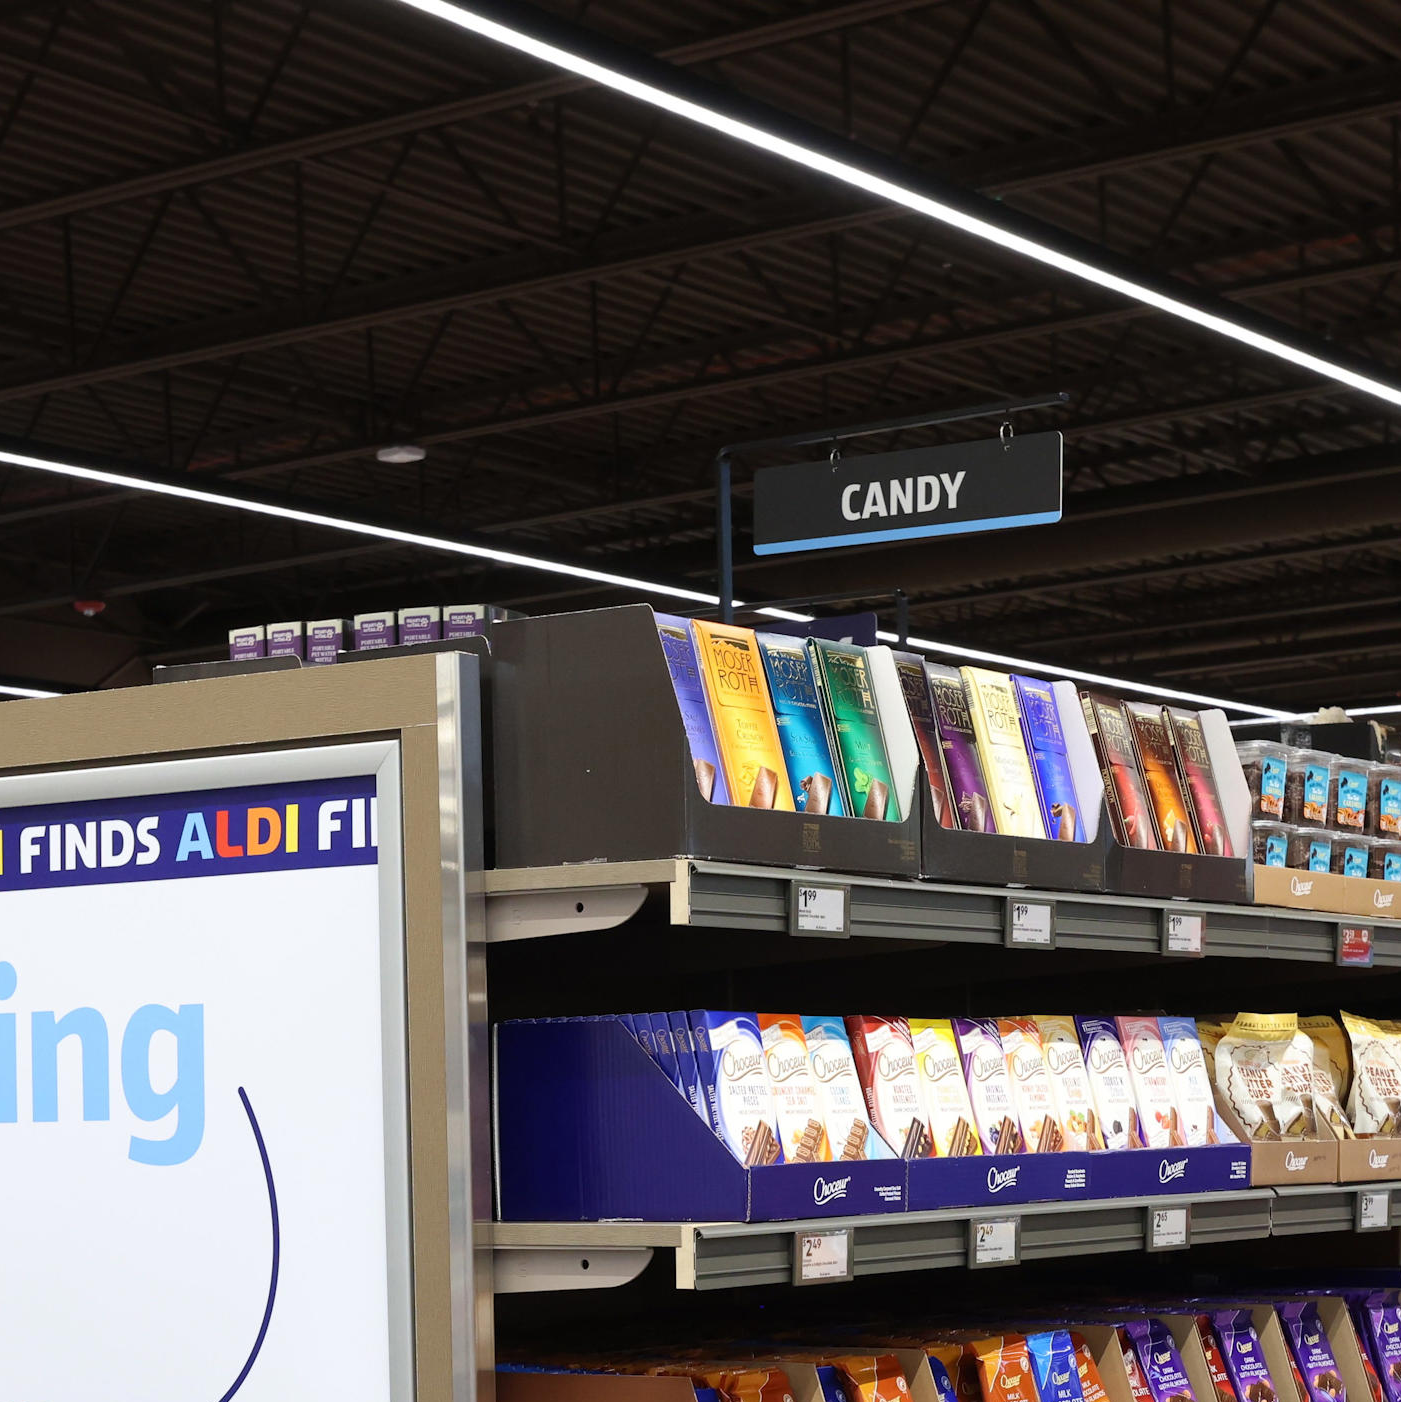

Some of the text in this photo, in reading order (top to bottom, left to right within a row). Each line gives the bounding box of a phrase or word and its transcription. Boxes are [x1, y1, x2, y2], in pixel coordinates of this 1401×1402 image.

[842, 471, 966, 522] CANDY
[713, 648, 755, 672] MOSER
[770, 657, 808, 679] MOSER
[718, 670, 760, 694] ROTH
[934, 684, 965, 708] MOSER
[982, 689, 1012, 711] MOSER
[940, 707, 972, 727] ROTH
[988, 709, 1018, 732] ROTH
[19, 815, 160, 873] FINDS
[175, 803, 299, 861] ALDI
[318, 797, 377, 851] FI
[988, 1166, 1020, 1191] Choceur
[1159, 1159, 1188, 1182] Choceur
[814, 1177, 851, 1204] Choceur
[1058, 1390, 1071, 1398] MILK
